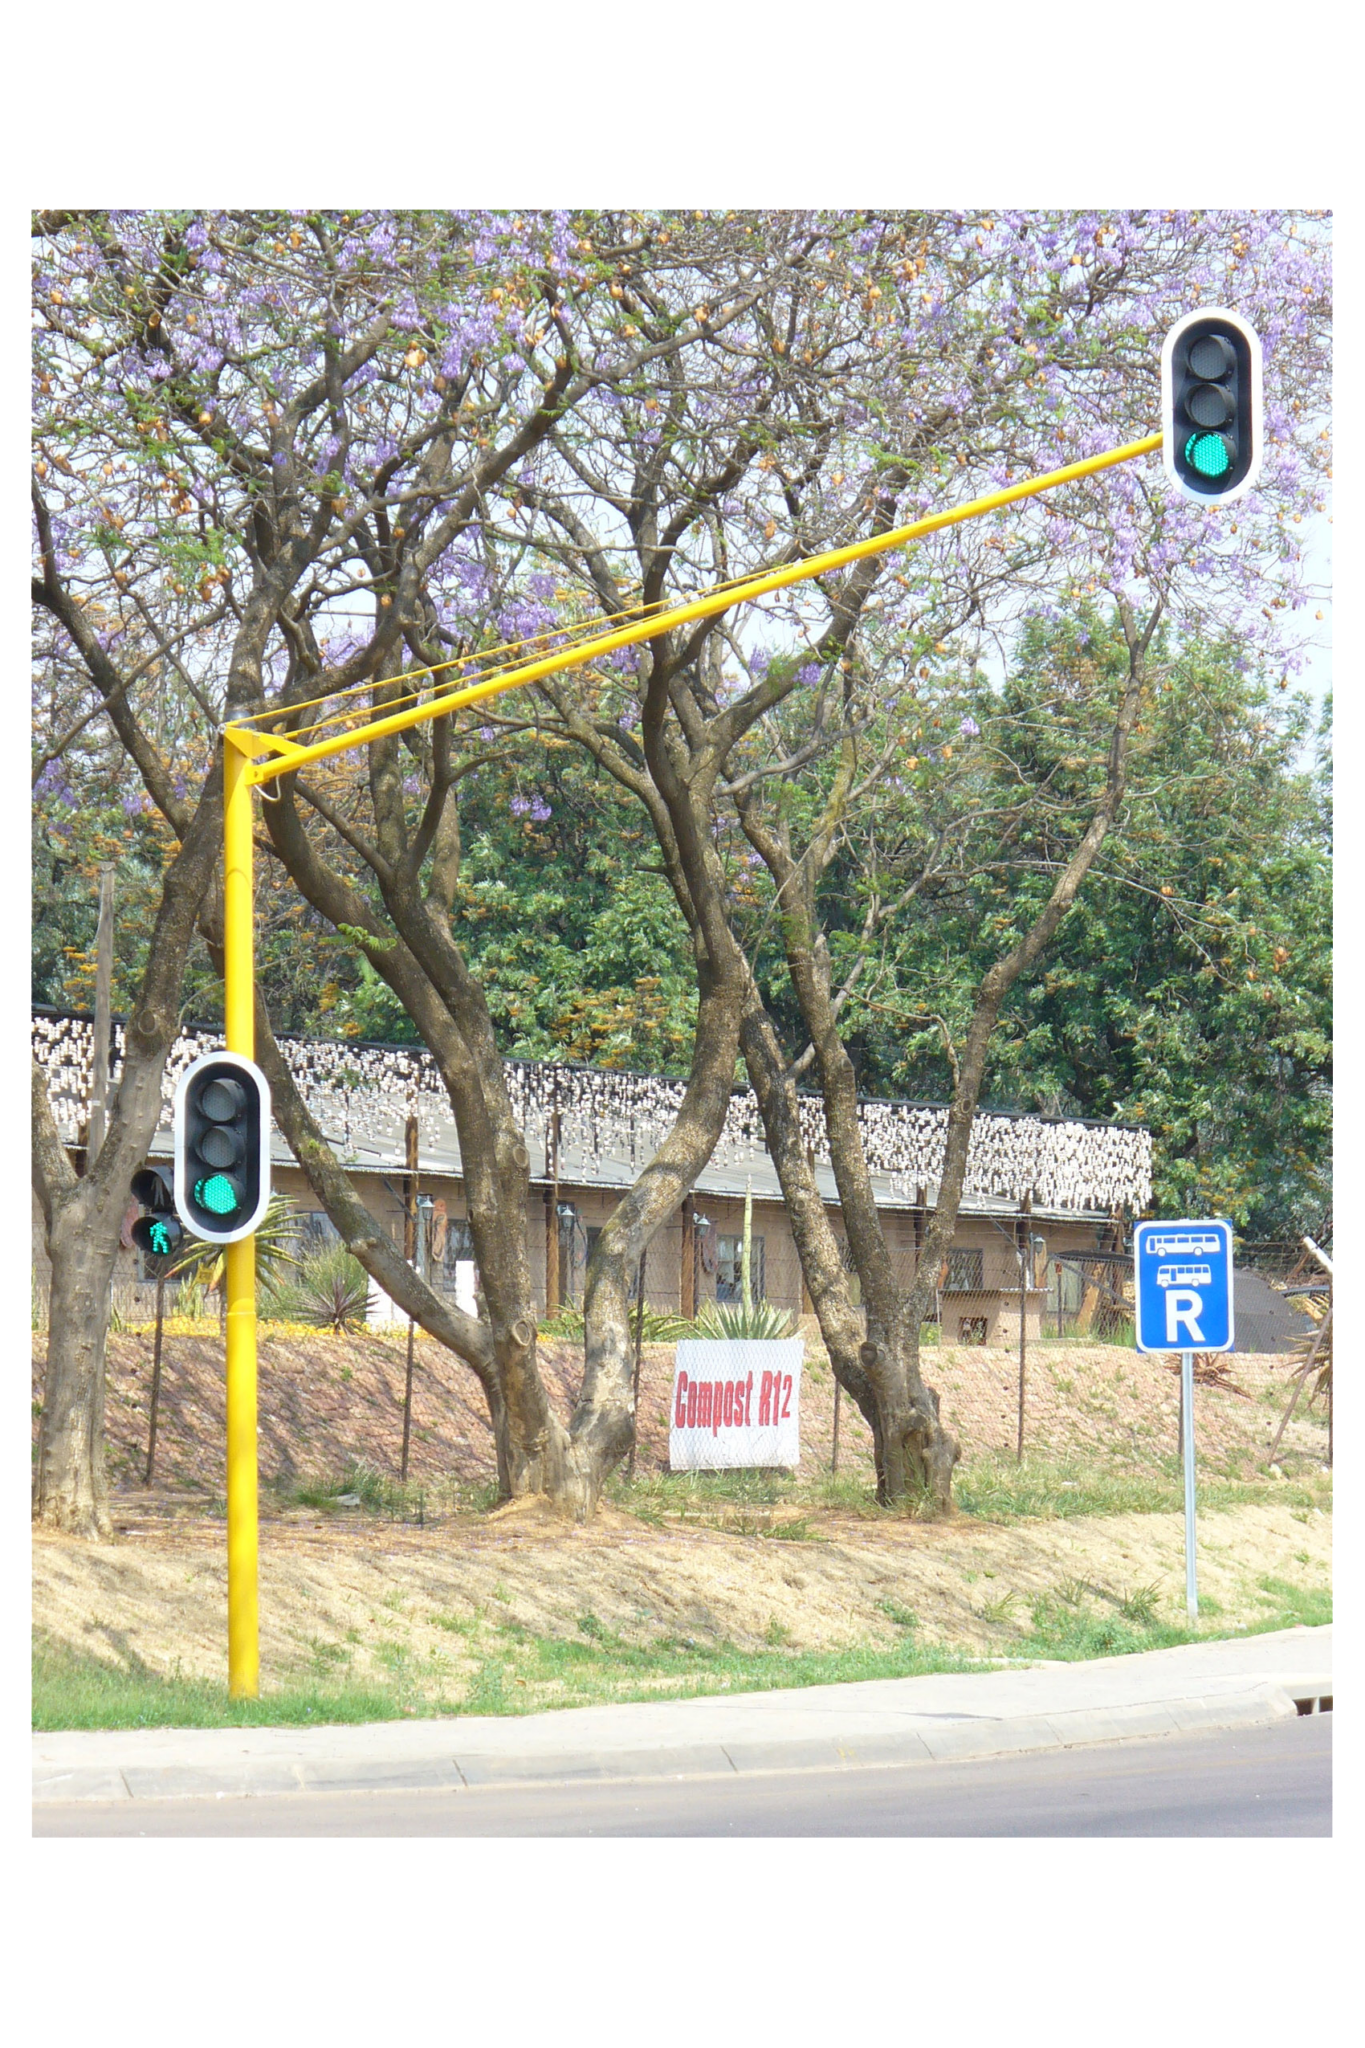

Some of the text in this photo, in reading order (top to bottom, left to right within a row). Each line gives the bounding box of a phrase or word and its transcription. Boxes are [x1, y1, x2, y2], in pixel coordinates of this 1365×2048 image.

[1165, 1289, 1206, 1342] R
[675, 1370, 793, 1437] Compost R12
